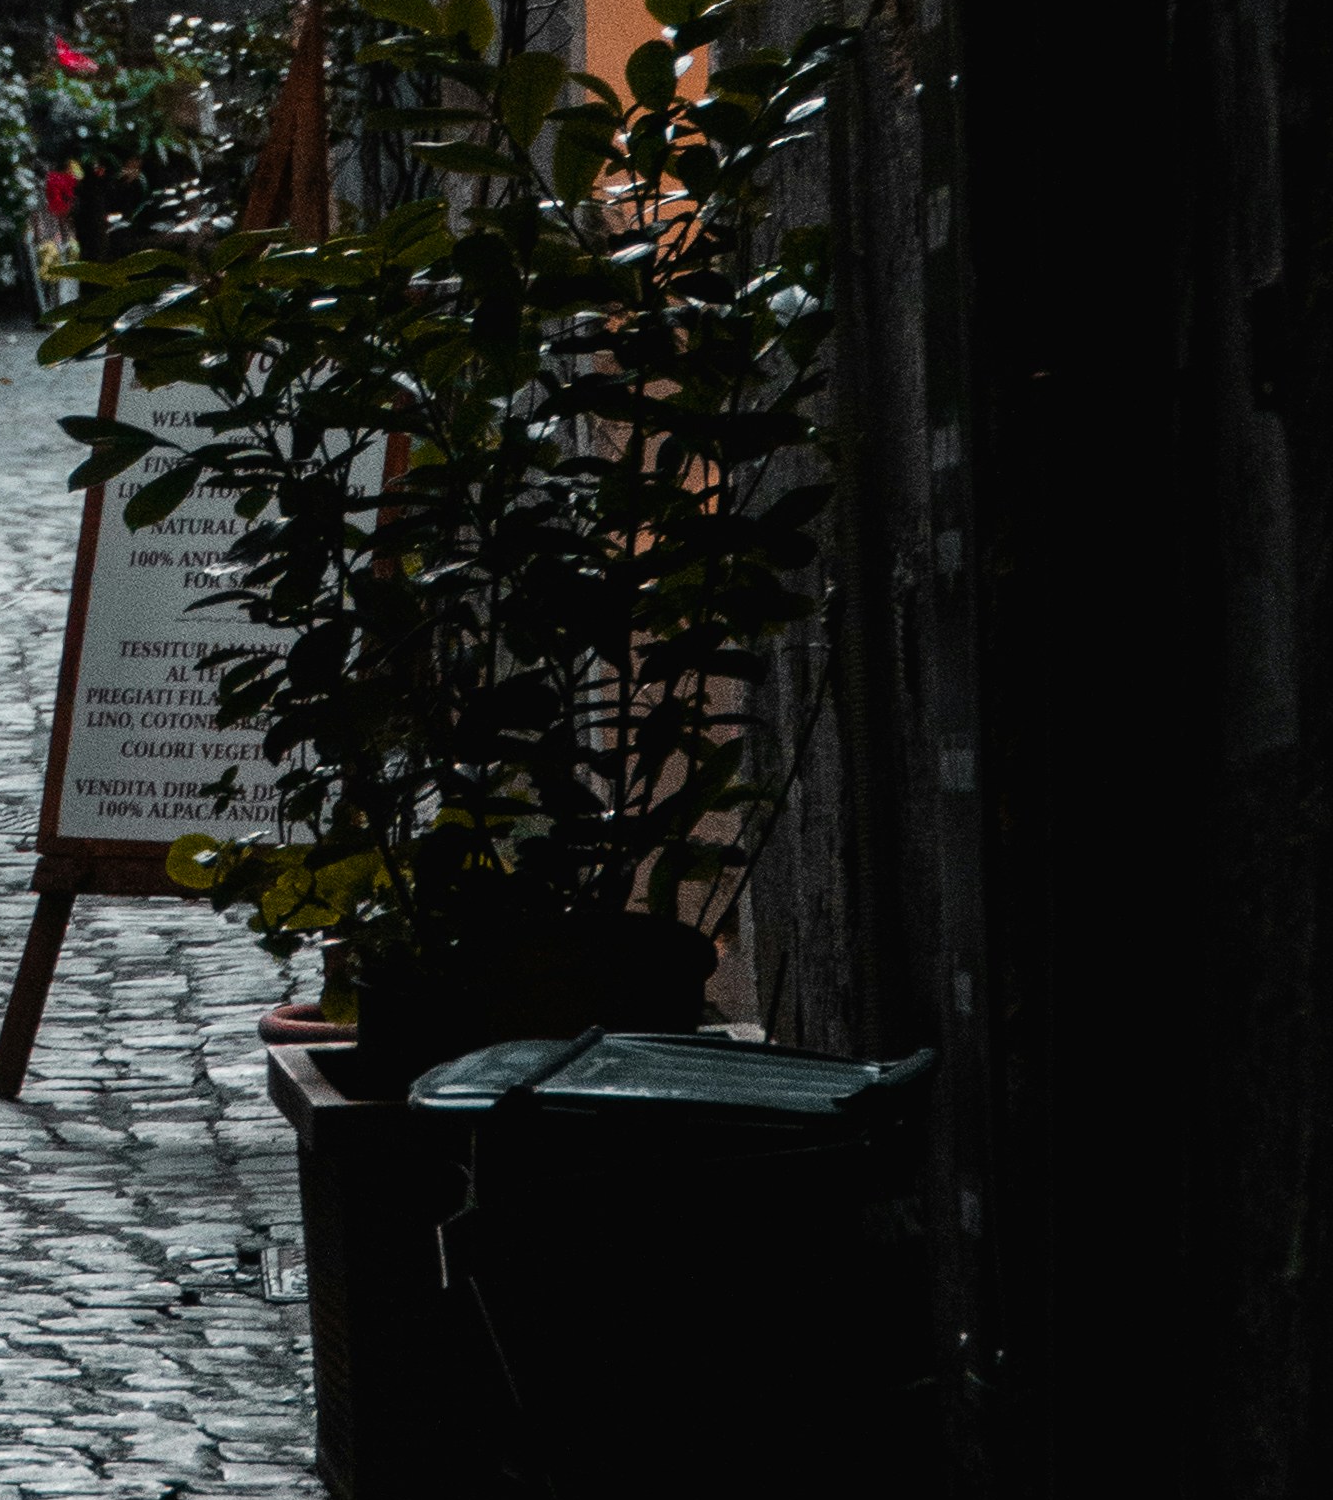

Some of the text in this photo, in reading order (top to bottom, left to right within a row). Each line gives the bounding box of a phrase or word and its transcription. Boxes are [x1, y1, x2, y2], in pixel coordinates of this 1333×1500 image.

[130, 550, 173, 567] 100%
[165, 665, 189, 683] AL
[86, 688, 174, 706] PREGIATI
[120, 741, 195, 760] COLORI
[74, 779, 156, 798] VENDITA
[97, 801, 142, 818] 100%
